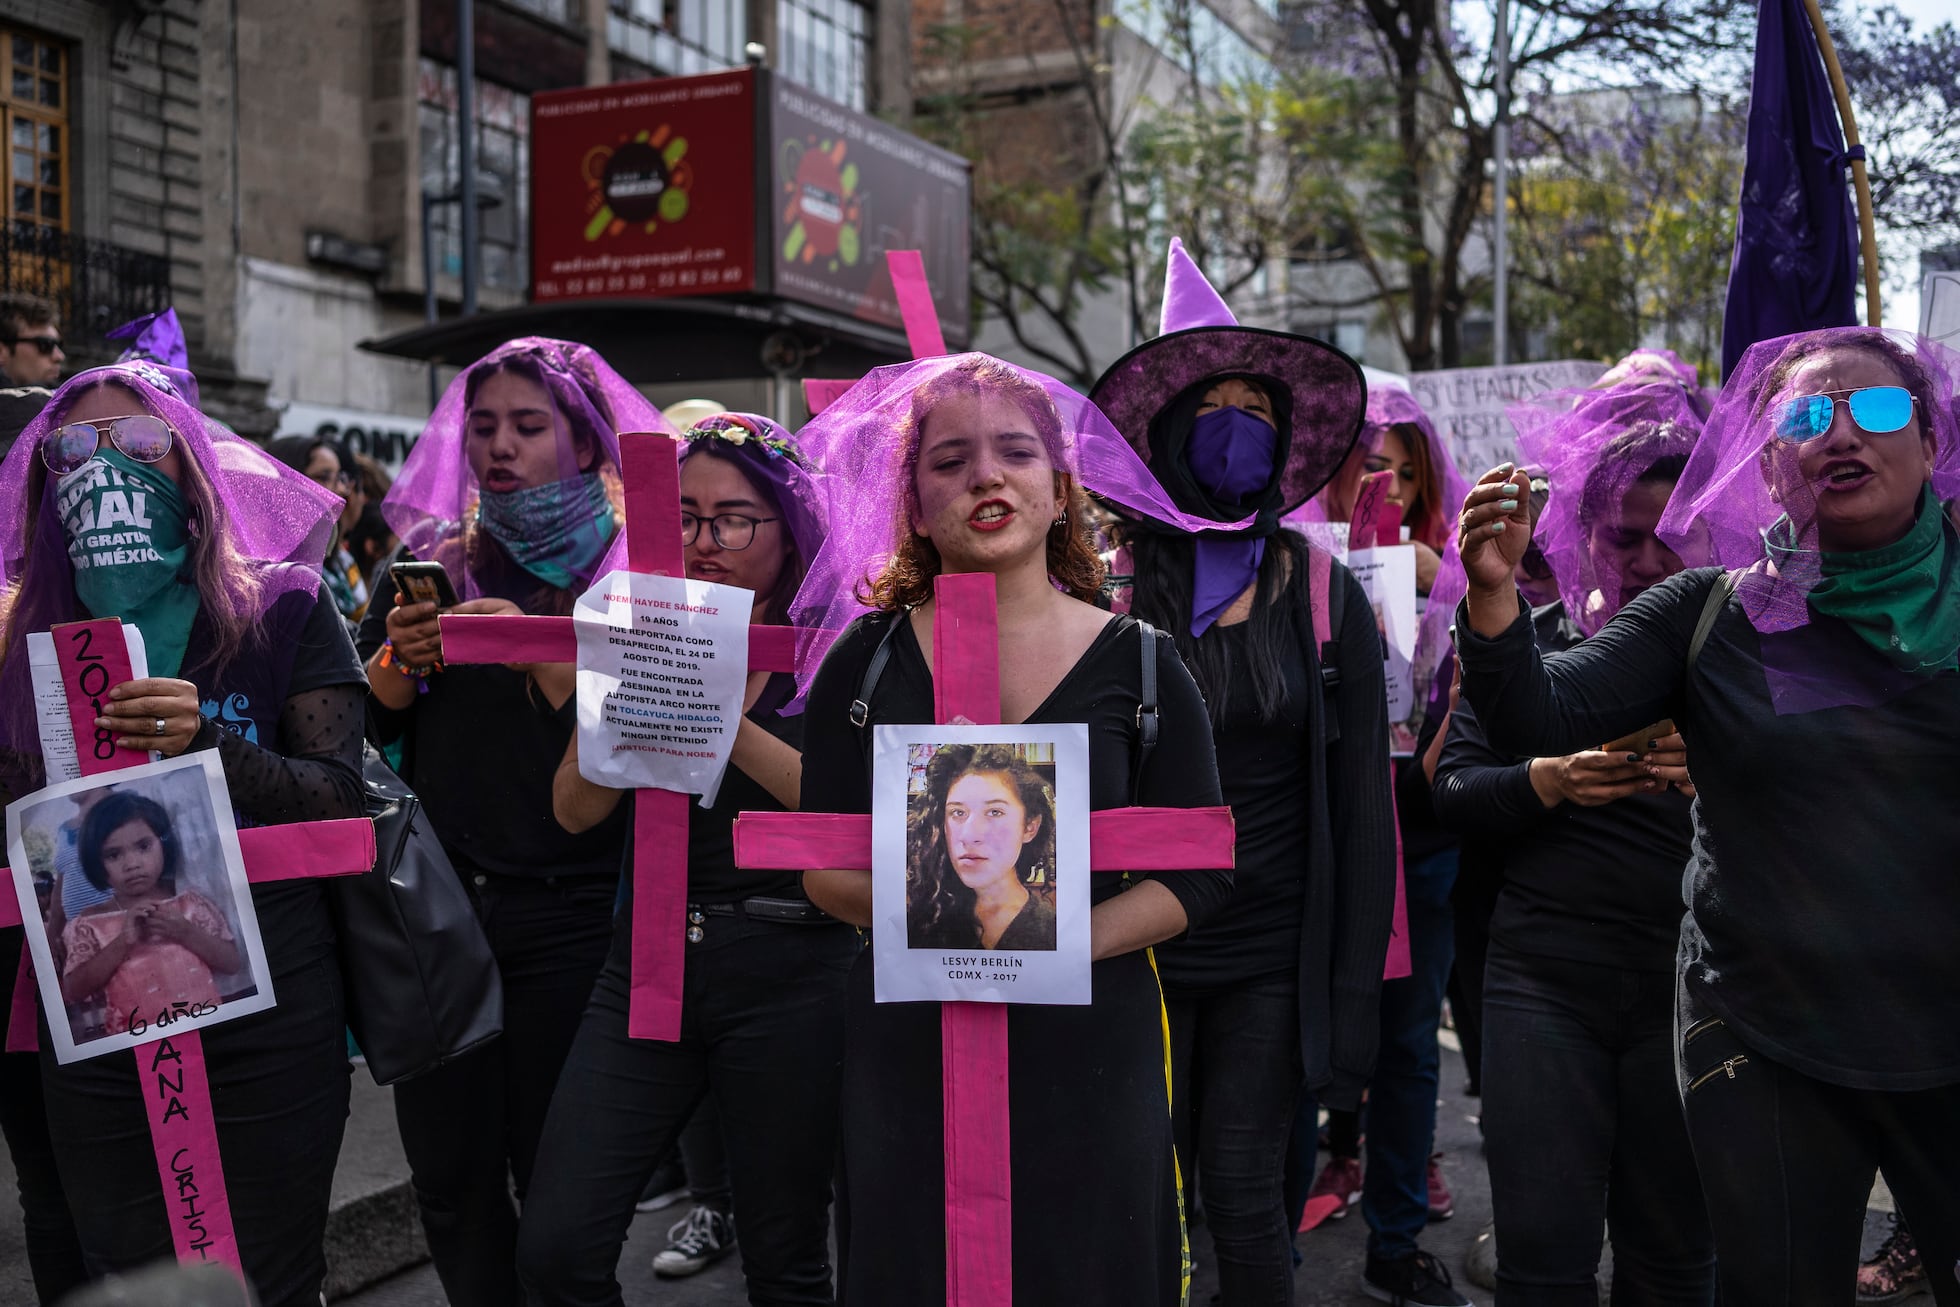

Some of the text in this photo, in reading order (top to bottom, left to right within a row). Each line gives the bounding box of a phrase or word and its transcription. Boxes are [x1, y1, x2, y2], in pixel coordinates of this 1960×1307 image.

[634, 598, 672, 610] HAYDEE
[653, 616, 679, 627] AÑOS
[608, 626, 714, 646] FUE REPORTADA COMO
[609, 637, 716, 660] DESAPRECIDA, EL 24 DE
[623, 652, 701, 671] AGOSTO DE 2019.
[621, 668, 704, 686] FUE ENCONTRADA
[72, 628, 116, 760] 2018
[620, 680, 704, 698] ASESINADA EN LA
[606, 691, 720, 711] AUTOPISTA ARCO NORTE
[605, 704, 724, 724] EN TOLCAYUCA HIDALGO,
[606, 716, 672, 731] ACTUALMENTE
[690, 726, 724, 734] EXISTE
[660, 735, 708, 744] DETENIDO
[660, 748, 684, 757] PARA
[942, 956, 1022, 968] LESVY BERLÍN
[948, 970, 982, 980] CDMX
[993, 973, 1017, 982] 2017
[128, 998, 218, 1036] 6 años
[152, 1038, 190, 1124] ANA
[171, 1148, 219, 1265] CRIST
